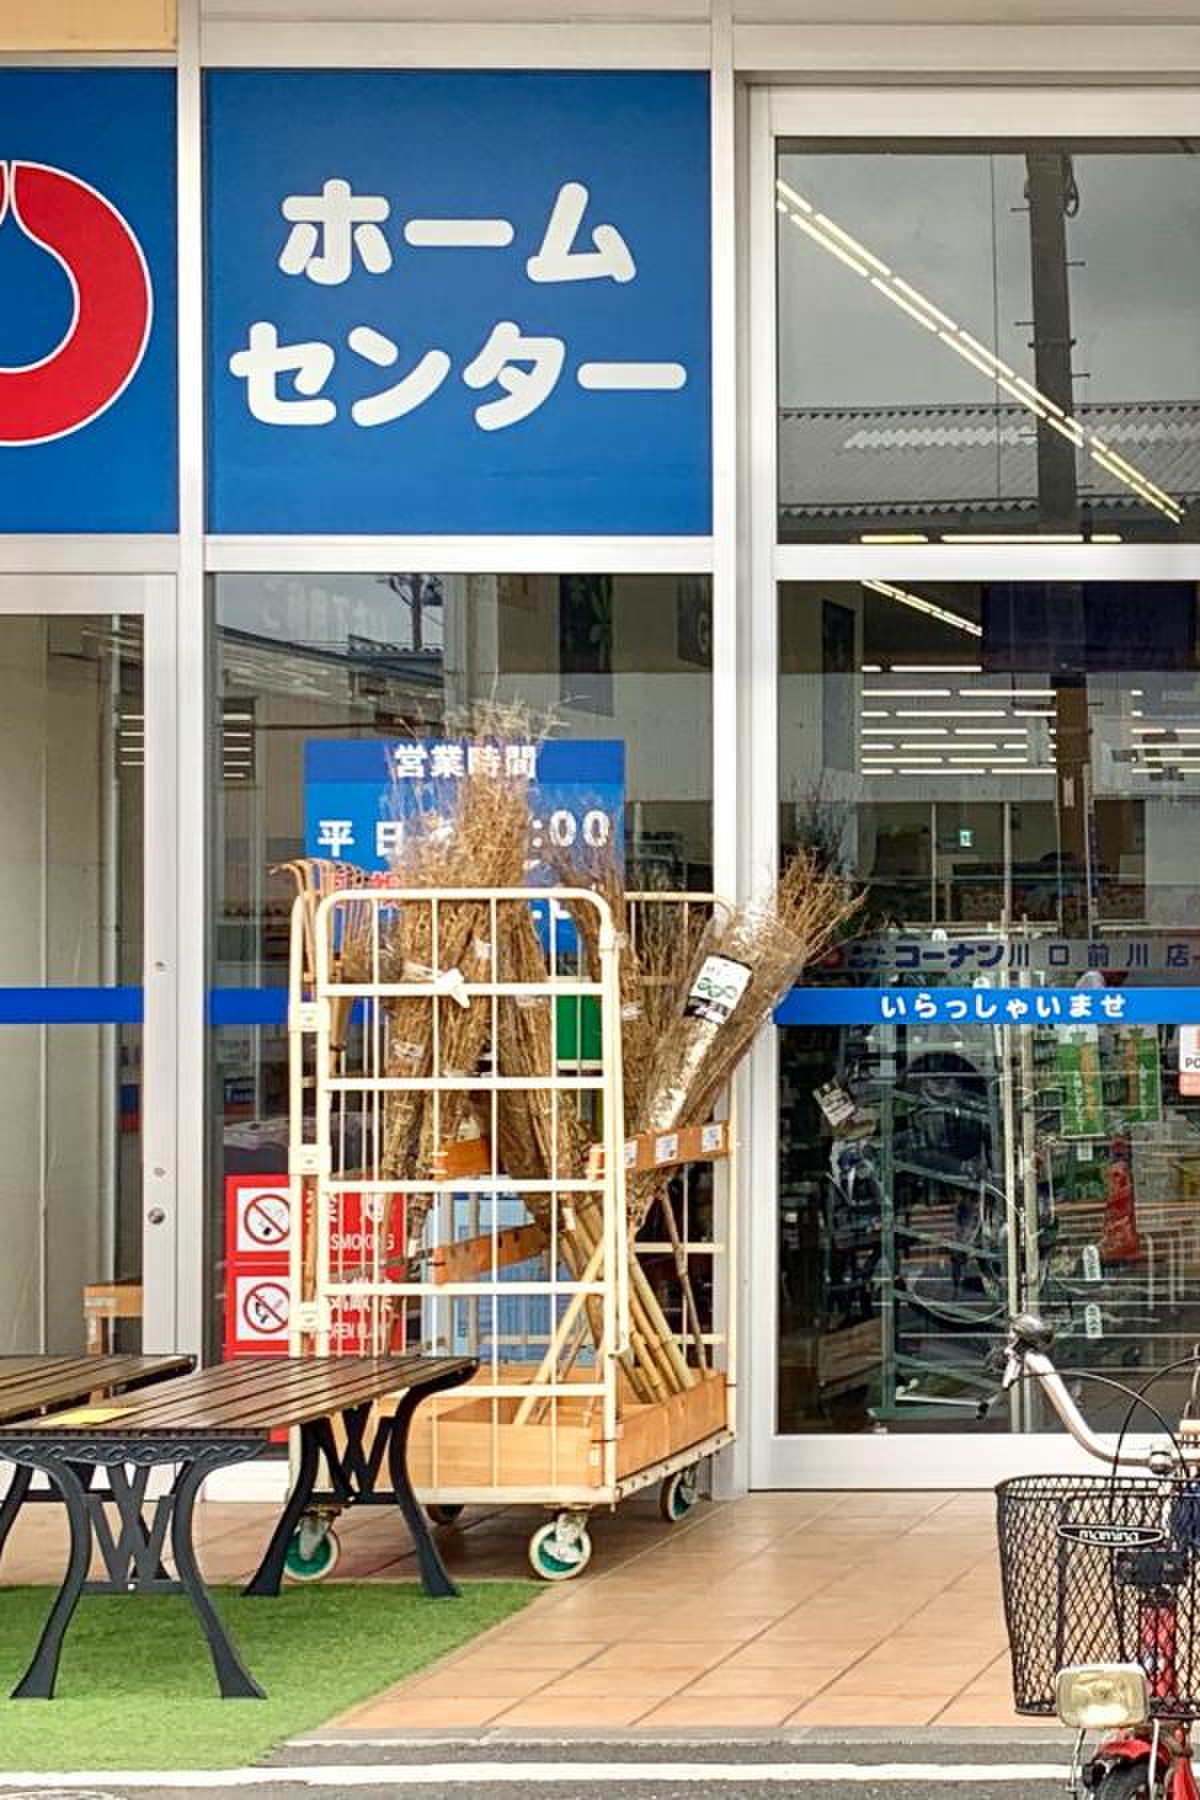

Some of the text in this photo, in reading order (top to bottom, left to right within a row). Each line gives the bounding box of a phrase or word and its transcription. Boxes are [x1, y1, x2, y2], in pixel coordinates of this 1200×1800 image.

[279, 178, 637, 286] ホーム
[229, 321, 687, 431] センター
[394, 744, 537, 779] 営業時間
[317, 820, 404, 858] 平日
[880, 992, 1127, 1019] いらっしゃいませ
